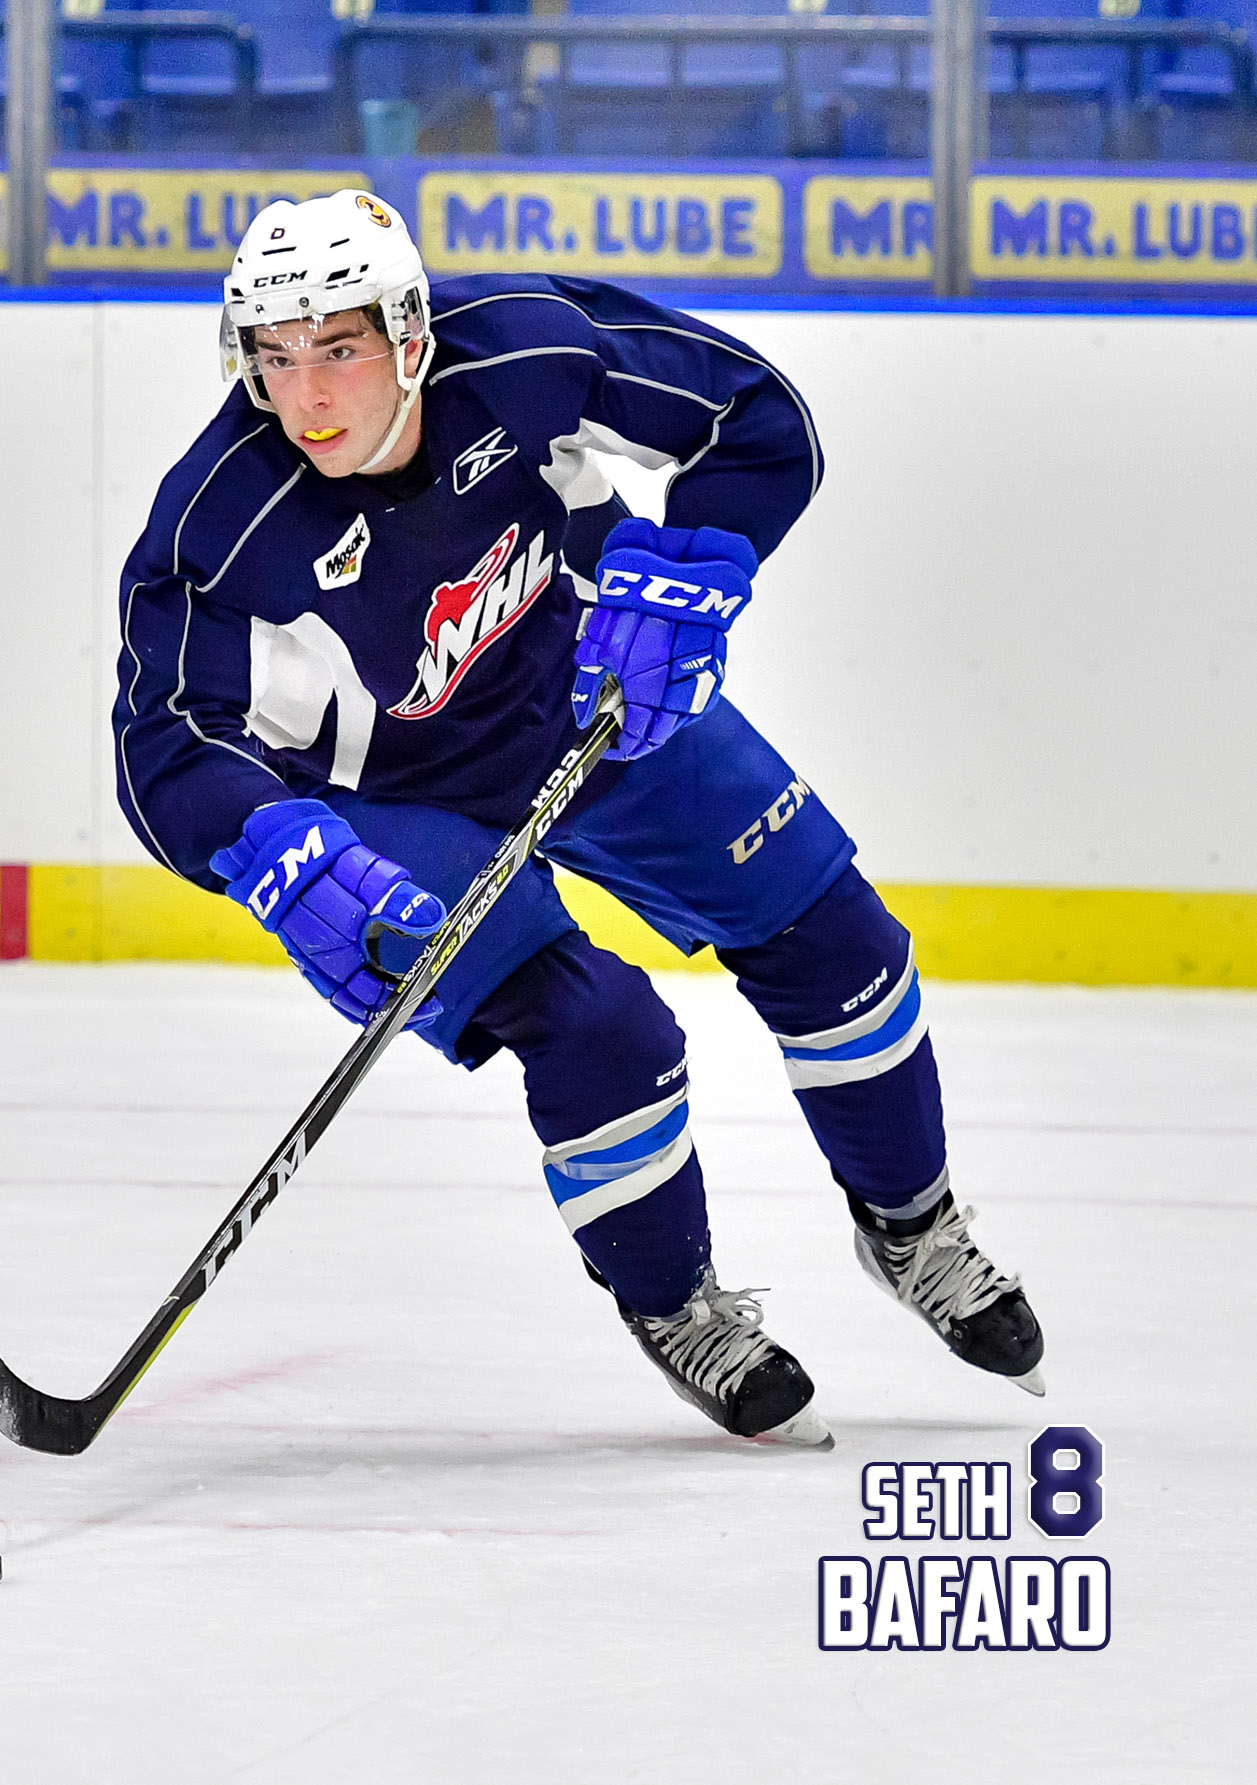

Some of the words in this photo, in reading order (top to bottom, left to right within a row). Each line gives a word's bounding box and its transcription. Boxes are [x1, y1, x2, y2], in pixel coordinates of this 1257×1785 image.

[45, 191, 168, 248] MR.
[445, 194, 576, 251] MR.
[596, 198, 755, 255] LUBE
[832, 200, 934, 257] MR
[990, 198, 1116, 257] MR.
[1134, 202, 1257, 260] LUB
[252, 269, 308, 289] CCM
[416, 529, 555, 702] WHL
[599, 568, 744, 620] CCM
[530, 748, 584, 810] CCM
[534, 766, 585, 841] CCM
[726, 774, 812, 865] CCM
[246, 825, 326, 921] CM
[841, 967, 889, 1014] CCM
